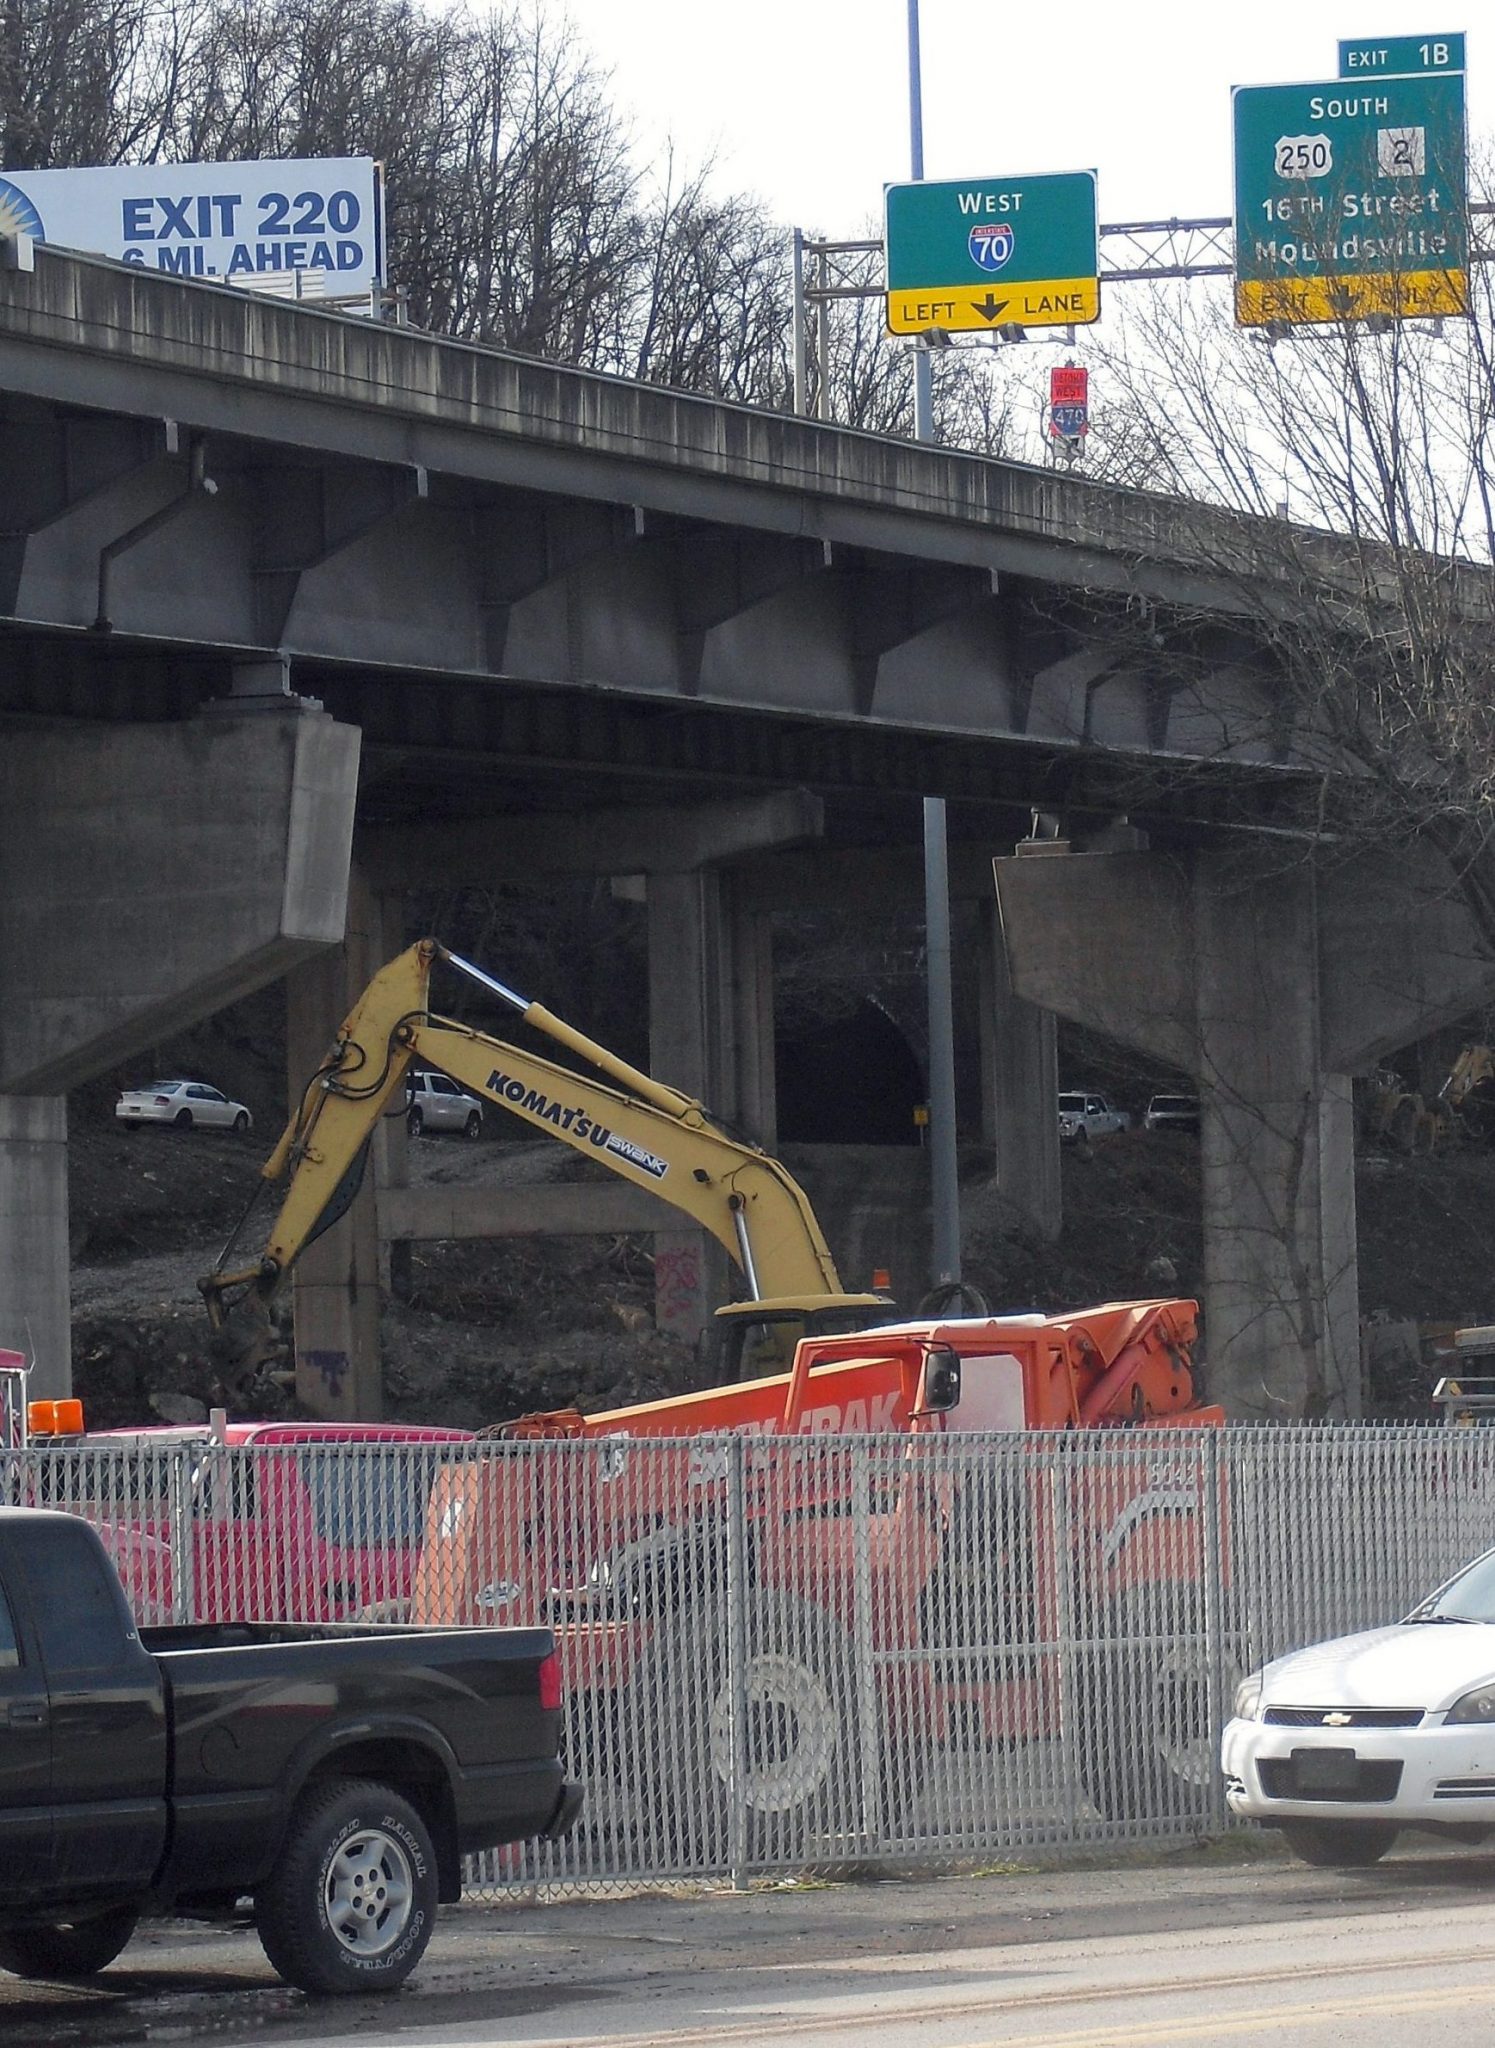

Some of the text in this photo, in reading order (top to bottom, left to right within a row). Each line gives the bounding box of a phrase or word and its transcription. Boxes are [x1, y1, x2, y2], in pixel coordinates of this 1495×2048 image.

[1347, 43, 1449, 67] EXIT 1B
[1310, 97, 1388, 119] SOUTH
[1280, 143, 1327, 170] 250
[1393, 140, 1410, 164] 2
[122, 190, 361, 241] EXIT 220
[957, 192, 1023, 214] WEST
[1262, 188, 1440, 221] 16TH Street
[228, 240, 364, 274] AHEAD
[975, 236, 1008, 262] 70
[903, 294, 1084, 322] LEFT LANE
[1055, 408, 1084, 425] 470
[485, 1069, 612, 1147] KOMATSU
[381, 1815, 427, 1879] RADIAL
